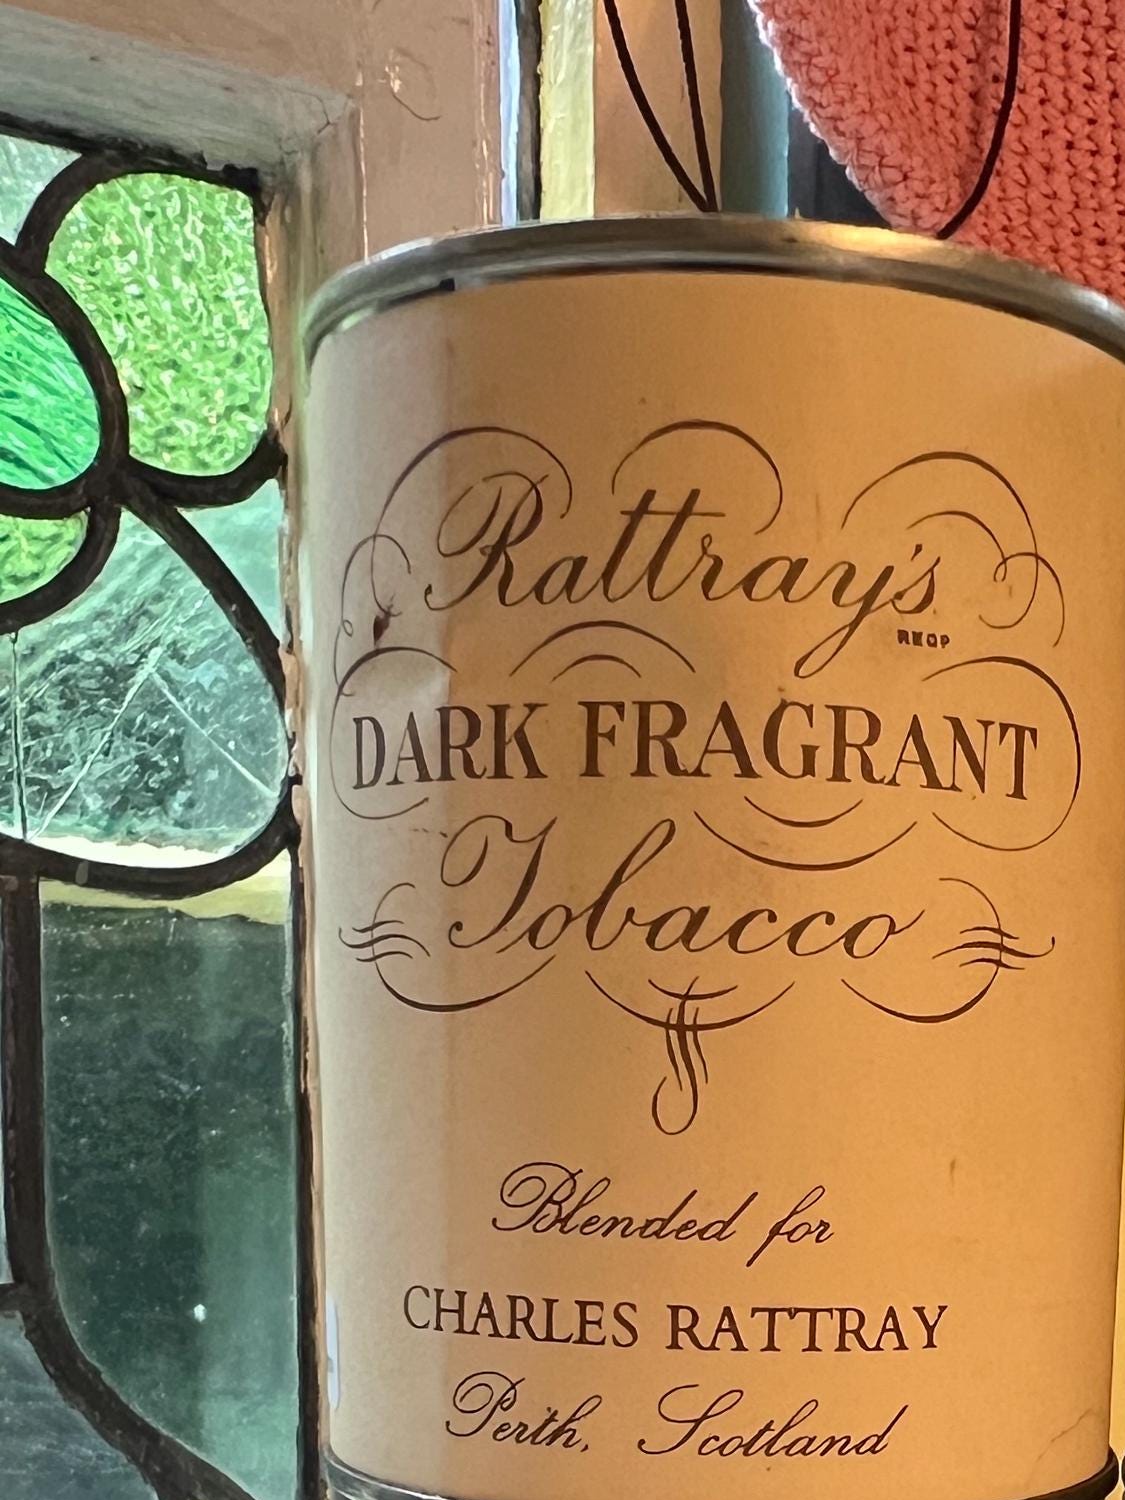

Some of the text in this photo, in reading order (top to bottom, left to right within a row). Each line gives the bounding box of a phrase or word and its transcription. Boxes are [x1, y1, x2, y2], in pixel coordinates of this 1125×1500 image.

[424, 472, 942, 678] Rattray's
[352, 700, 1038, 801] DARK FRAGRANT
[440, 815, 925, 958] Tobacco
[492, 1162, 834, 1267] Blended for
[403, 1285, 948, 1353] CHARLES RATTRAY
[445, 1371, 908, 1458] Perth, Scotland
